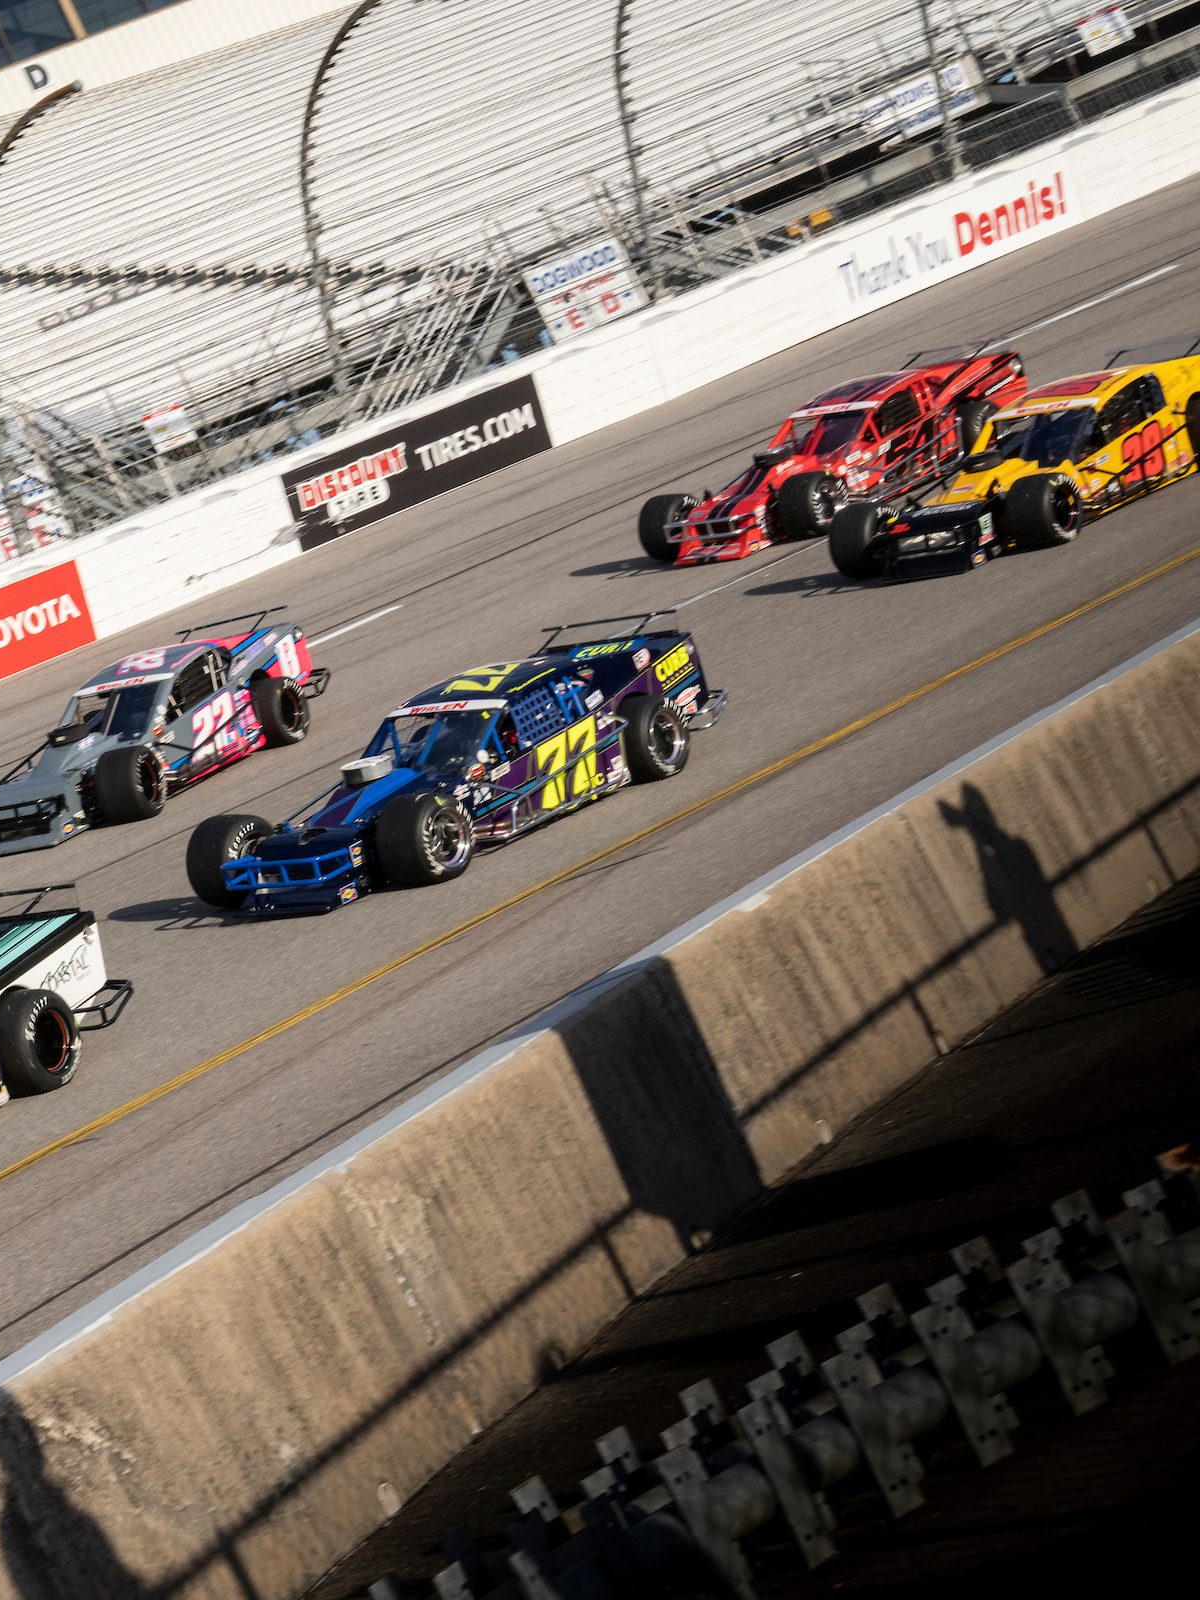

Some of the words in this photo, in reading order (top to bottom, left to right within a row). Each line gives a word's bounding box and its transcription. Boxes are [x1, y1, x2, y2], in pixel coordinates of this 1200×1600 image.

[25, 64, 49, 91] D
[953, 172, 1067, 258] Dennis!
[414, 403, 537, 472] TIRES.COM
[296, 442, 408, 512] DISCOUNT
[655, 646, 690, 683] CURB
[191, 690, 236, 763] 22
[410, 702, 469, 715] WHELEN
[535, 713, 598, 810] 77
